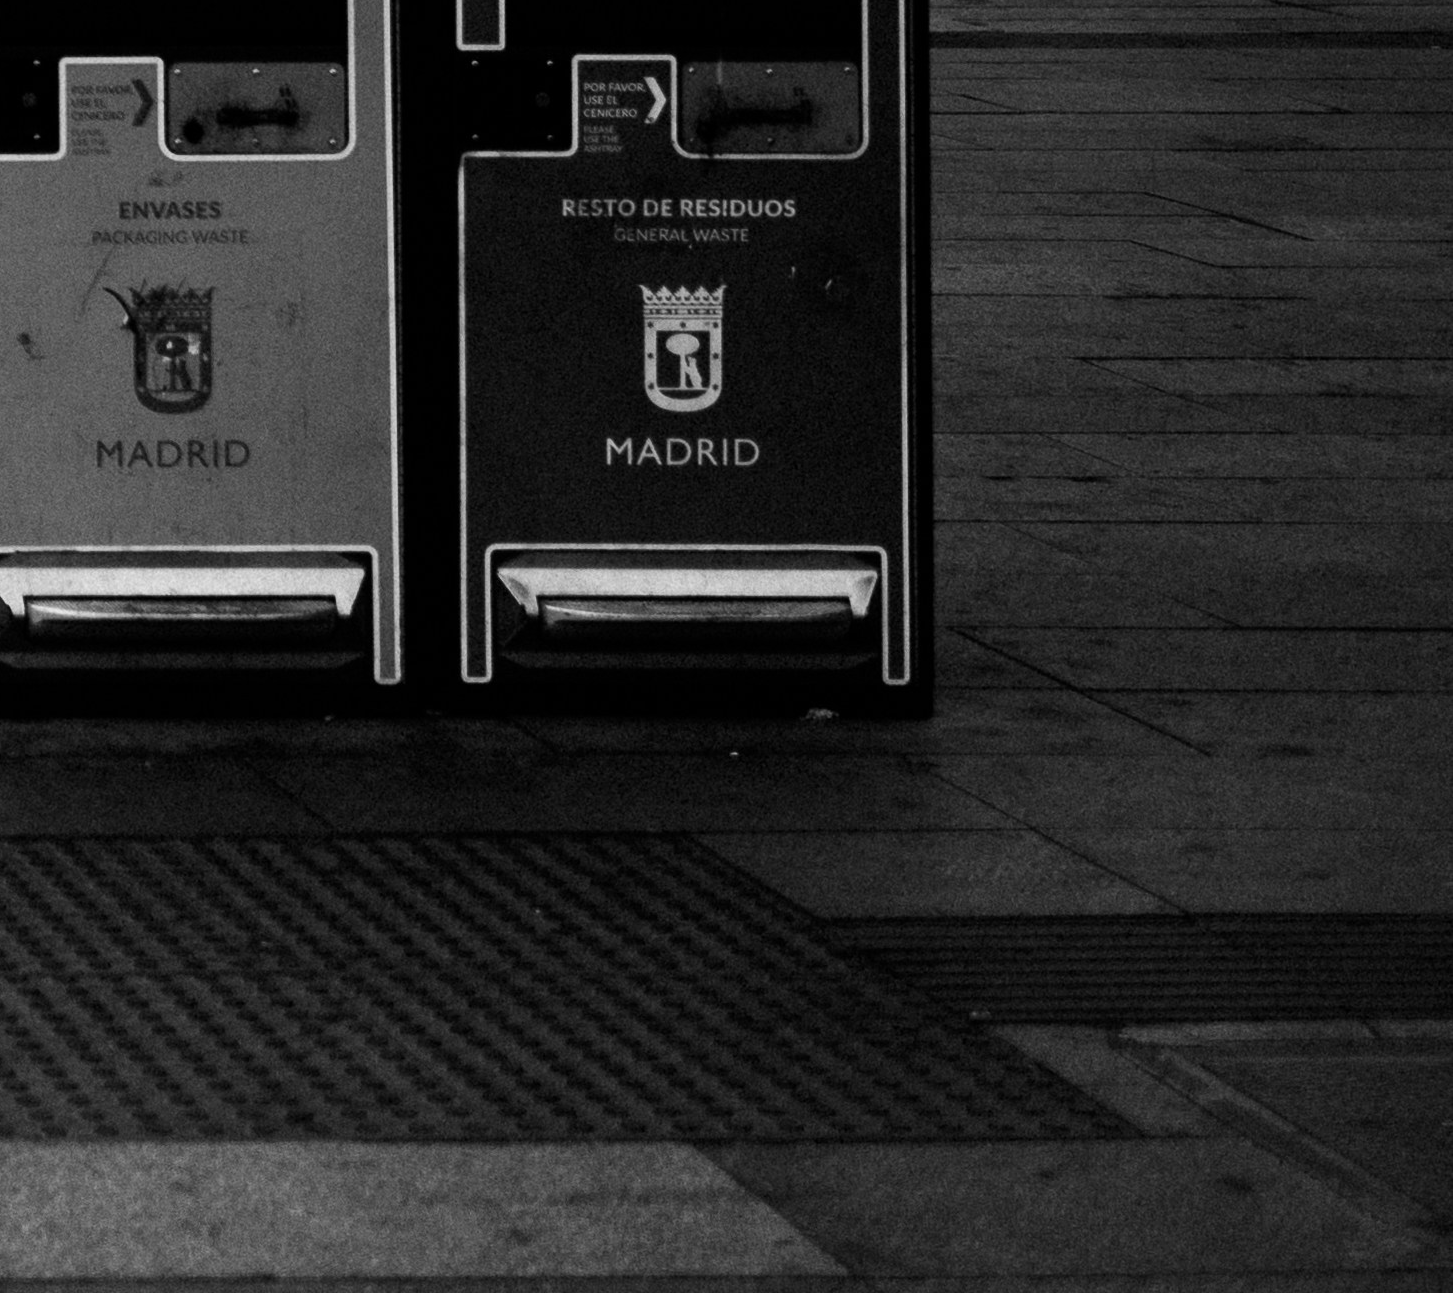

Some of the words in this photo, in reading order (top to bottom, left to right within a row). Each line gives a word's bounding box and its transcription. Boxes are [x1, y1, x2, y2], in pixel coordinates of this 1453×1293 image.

[583, 82, 606, 93] POR
[583, 95, 603, 105] USE
[606, 95, 618, 105] EL
[583, 108, 638, 119] CENICERO
[118, 201, 222, 220] ENVASES
[562, 199, 636, 217] RESTO
[643, 199, 672, 217] DE
[679, 199, 796, 217] RESIDUOS
[91, 230, 188, 245] PACKAGING
[191, 229, 249, 244] WASTE
[614, 228, 689, 242] GENERAL
[692, 228, 749, 242] WASTE
[96, 440, 250, 469] MADRID
[606, 438, 760, 466] MADRID
